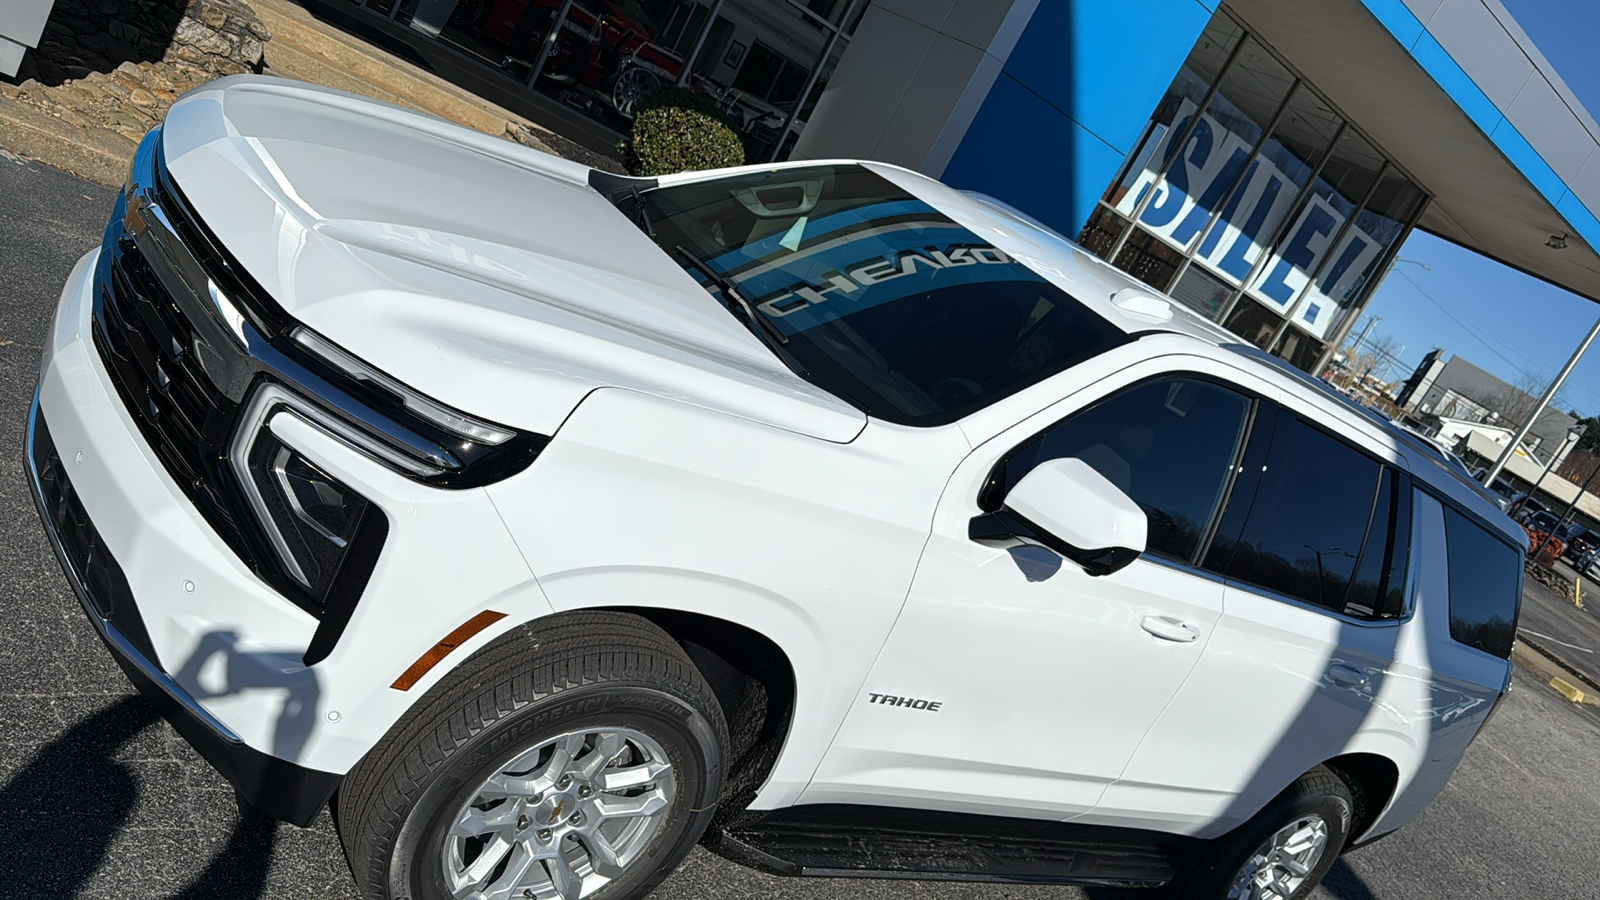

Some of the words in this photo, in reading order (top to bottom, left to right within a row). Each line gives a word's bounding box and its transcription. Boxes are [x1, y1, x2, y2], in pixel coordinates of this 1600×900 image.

[1133, 114, 1369, 325] SALE!
[490, 697, 602, 751] MICHELIN
[868, 692, 943, 712] TAHOE
